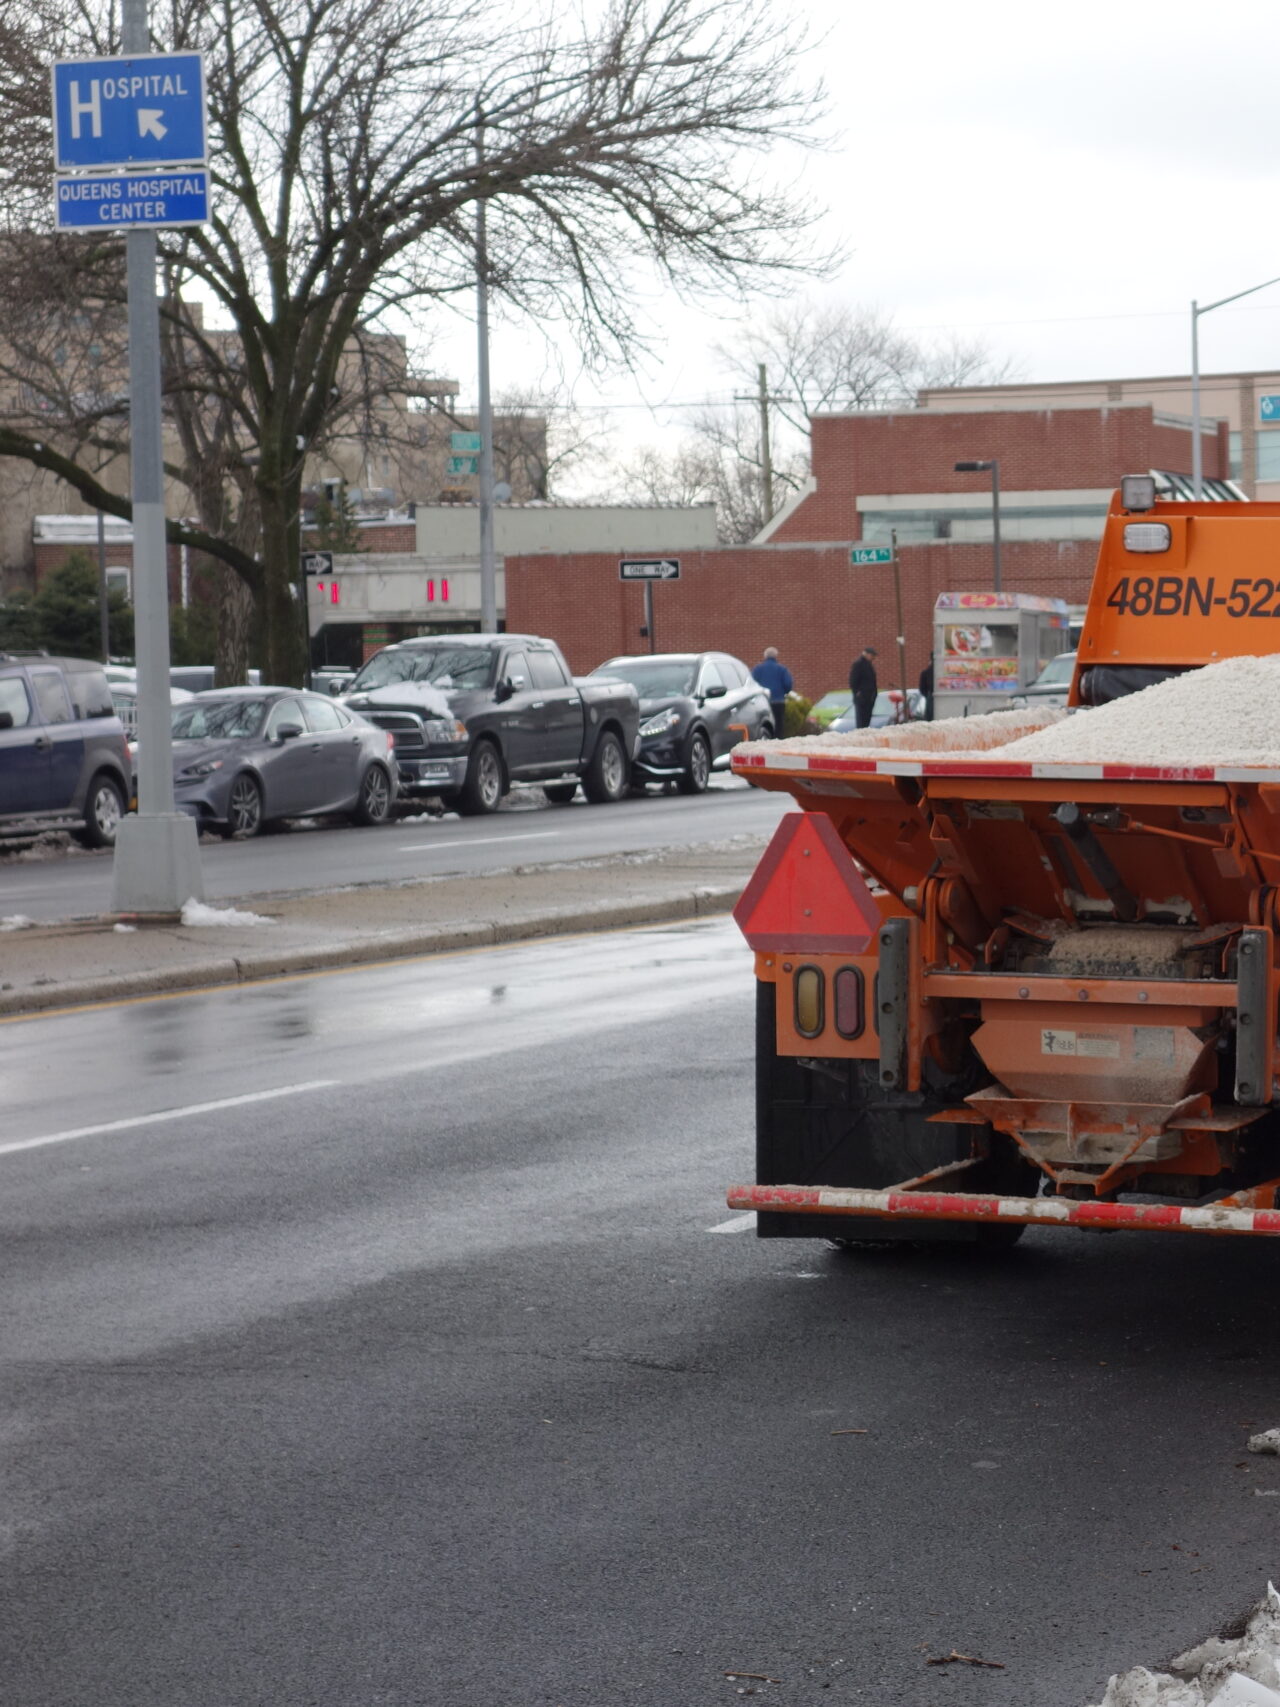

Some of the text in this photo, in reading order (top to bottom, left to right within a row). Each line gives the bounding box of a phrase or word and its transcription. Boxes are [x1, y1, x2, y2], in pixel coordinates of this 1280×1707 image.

[70, 74, 188, 139] HOSPITAL
[60, 179, 204, 201] QUEENS HOSPITAL
[100, 201, 166, 220] CENTER
[309, 558, 324, 568] WAY
[855, 550, 877, 562] 164
[630, 565, 669, 574] ONE WAY
